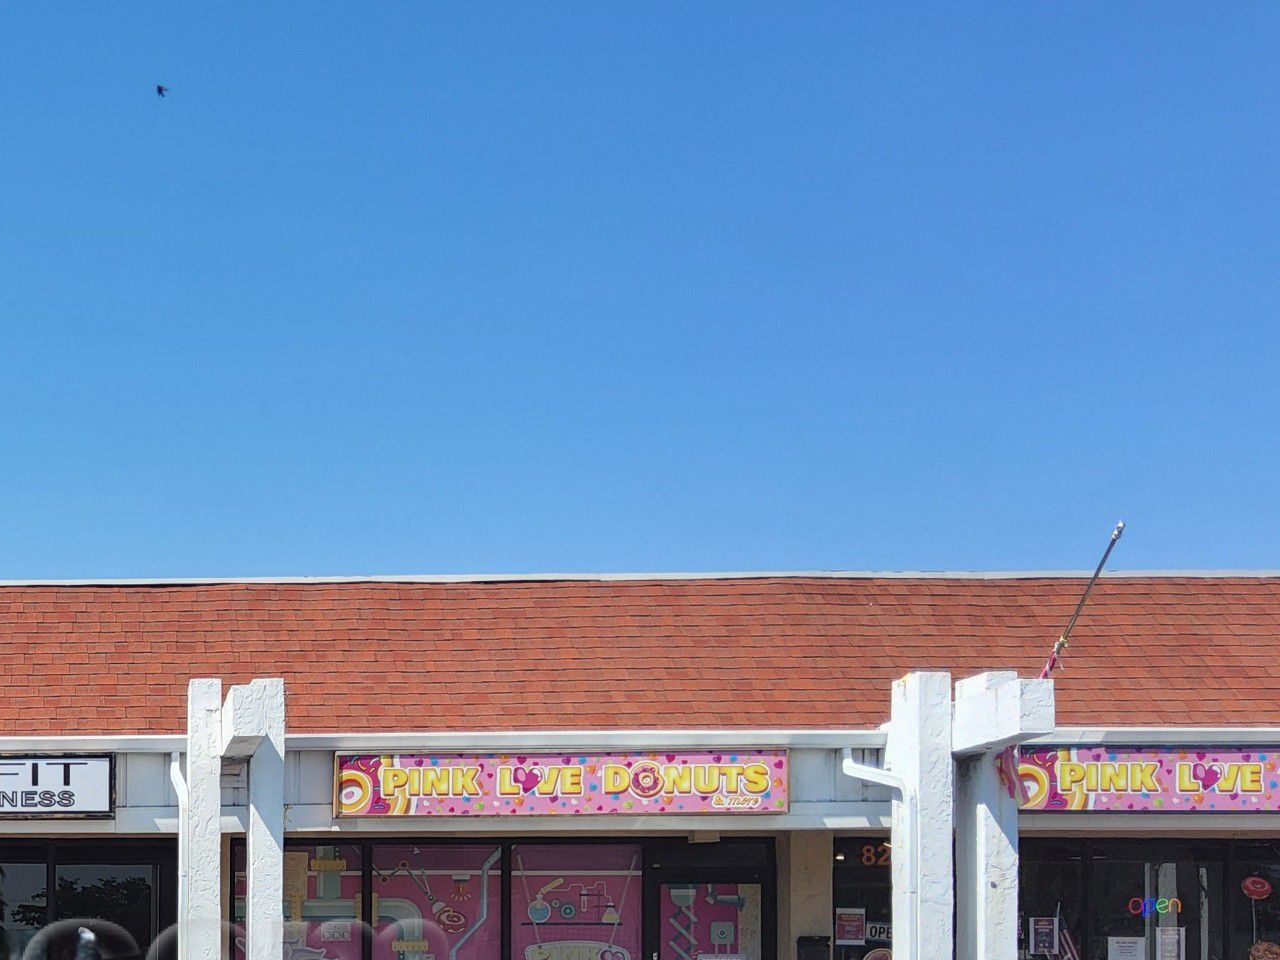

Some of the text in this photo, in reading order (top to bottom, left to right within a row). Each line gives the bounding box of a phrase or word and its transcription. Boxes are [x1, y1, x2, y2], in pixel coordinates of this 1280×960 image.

[381, 764, 483, 797] PINK
[602, 760, 771, 799] DONUTS
[1058, 761, 1161, 794] PINK
[728, 795, 760, 806] more
[1128, 897, 1182, 918] open
[870, 926, 892, 939] OPE
